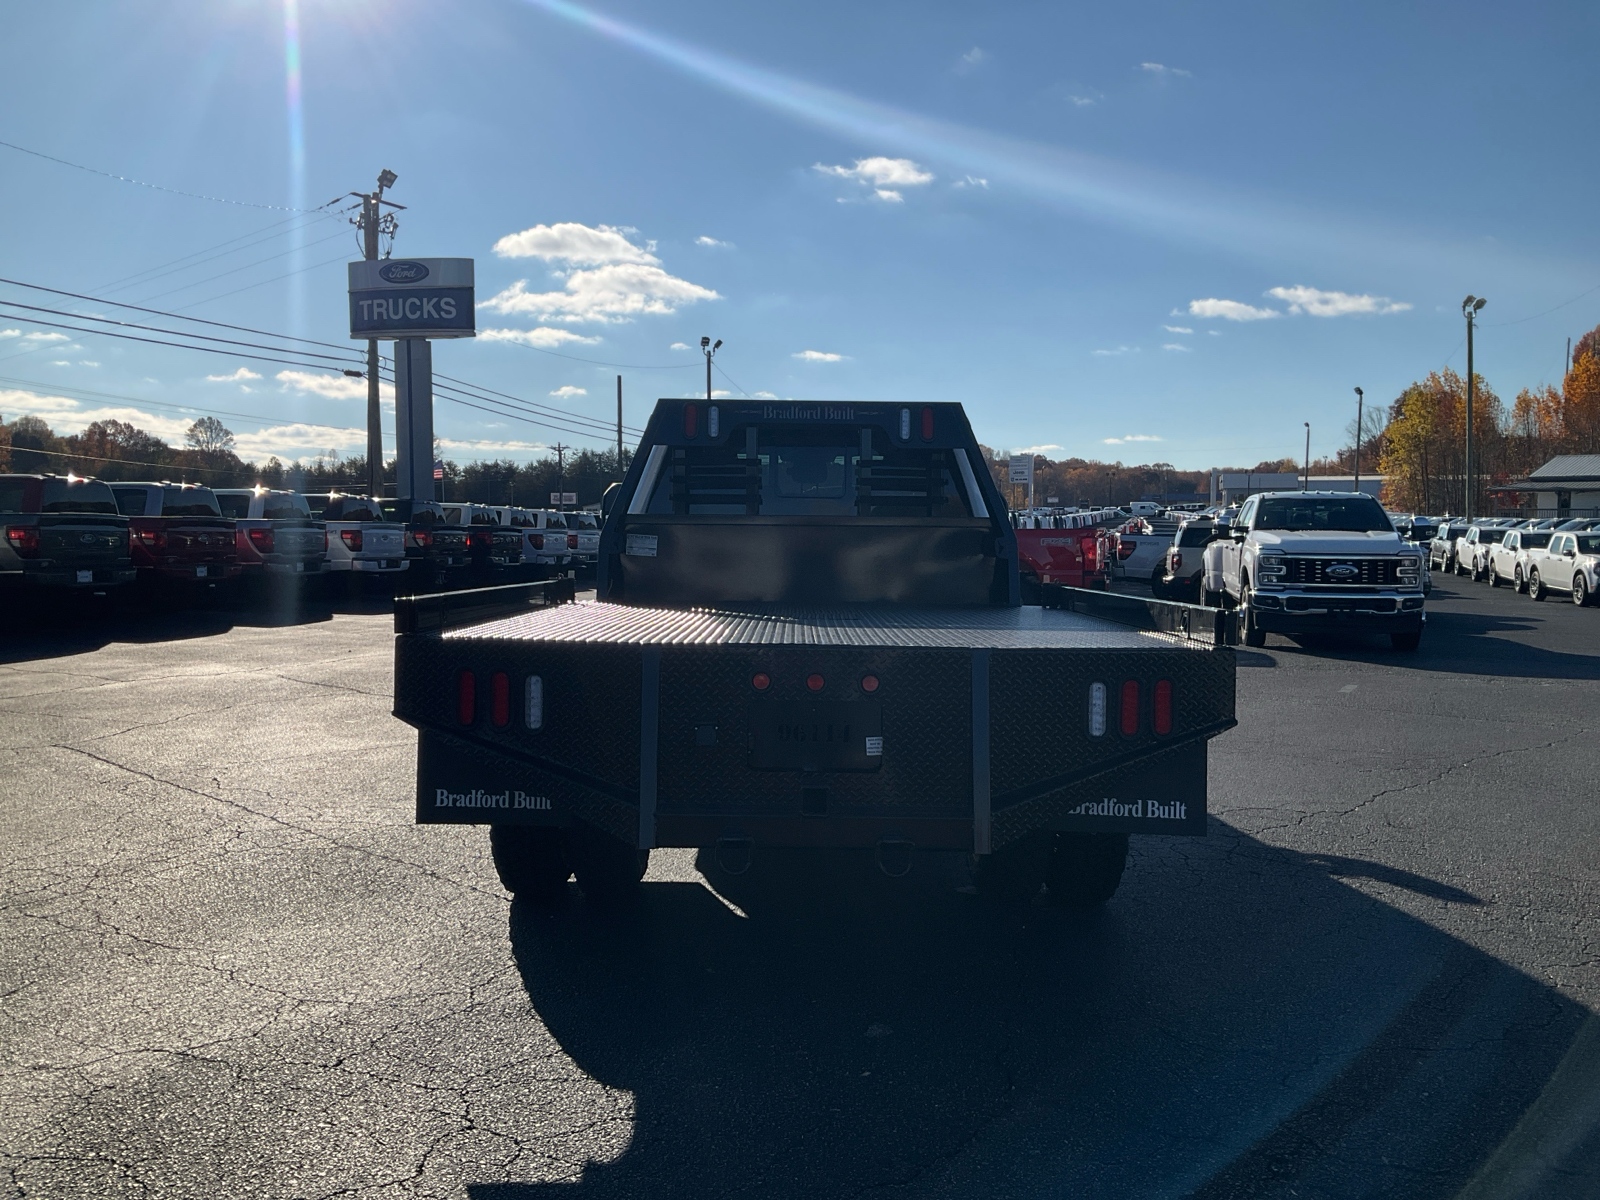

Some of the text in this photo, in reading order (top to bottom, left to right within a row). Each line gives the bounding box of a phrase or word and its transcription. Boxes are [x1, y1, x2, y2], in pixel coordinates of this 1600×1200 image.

[389, 265, 416, 278] Ford
[359, 297, 457, 321] TRUCKS
[763, 405, 855, 420] Bradford Built
[434, 788, 510, 808] Bradford
[1146, 799, 1187, 820] Built
